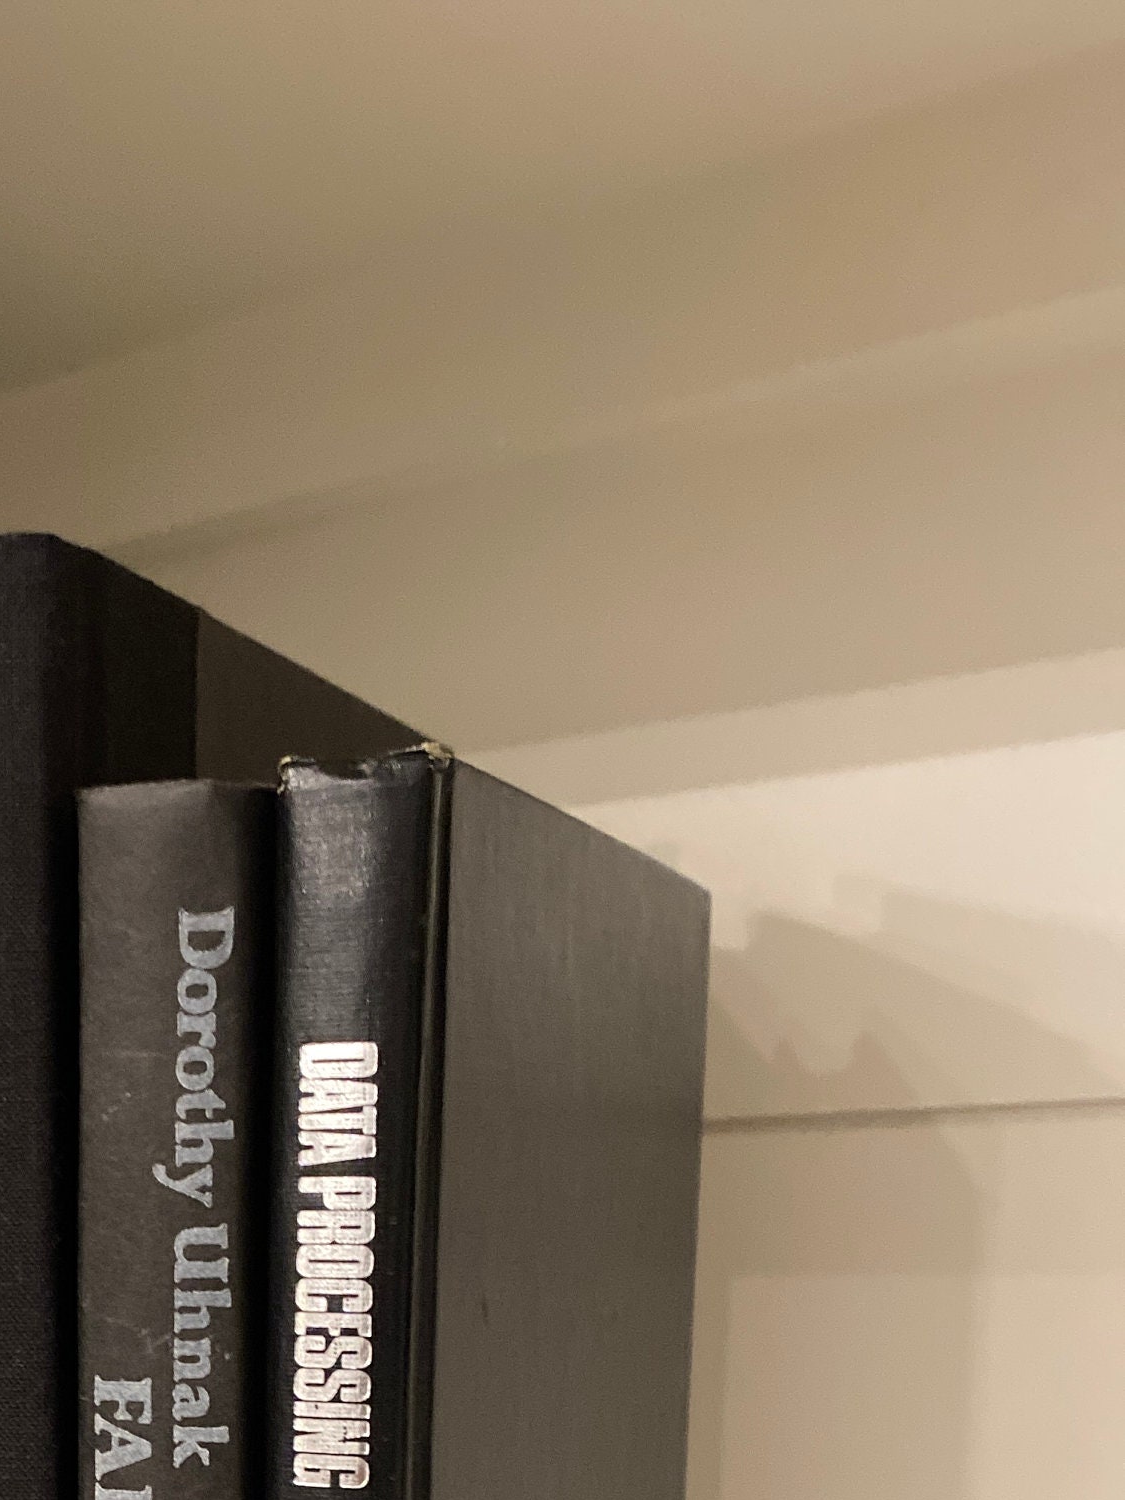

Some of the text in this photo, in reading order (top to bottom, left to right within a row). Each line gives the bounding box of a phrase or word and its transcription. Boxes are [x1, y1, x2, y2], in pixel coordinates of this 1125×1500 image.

[151, 905, 235, 1469] Dorothy Uhnak
[297, 1041, 379, 1164] DATA
[292, 1175, 377, 1489] PROCESSING
